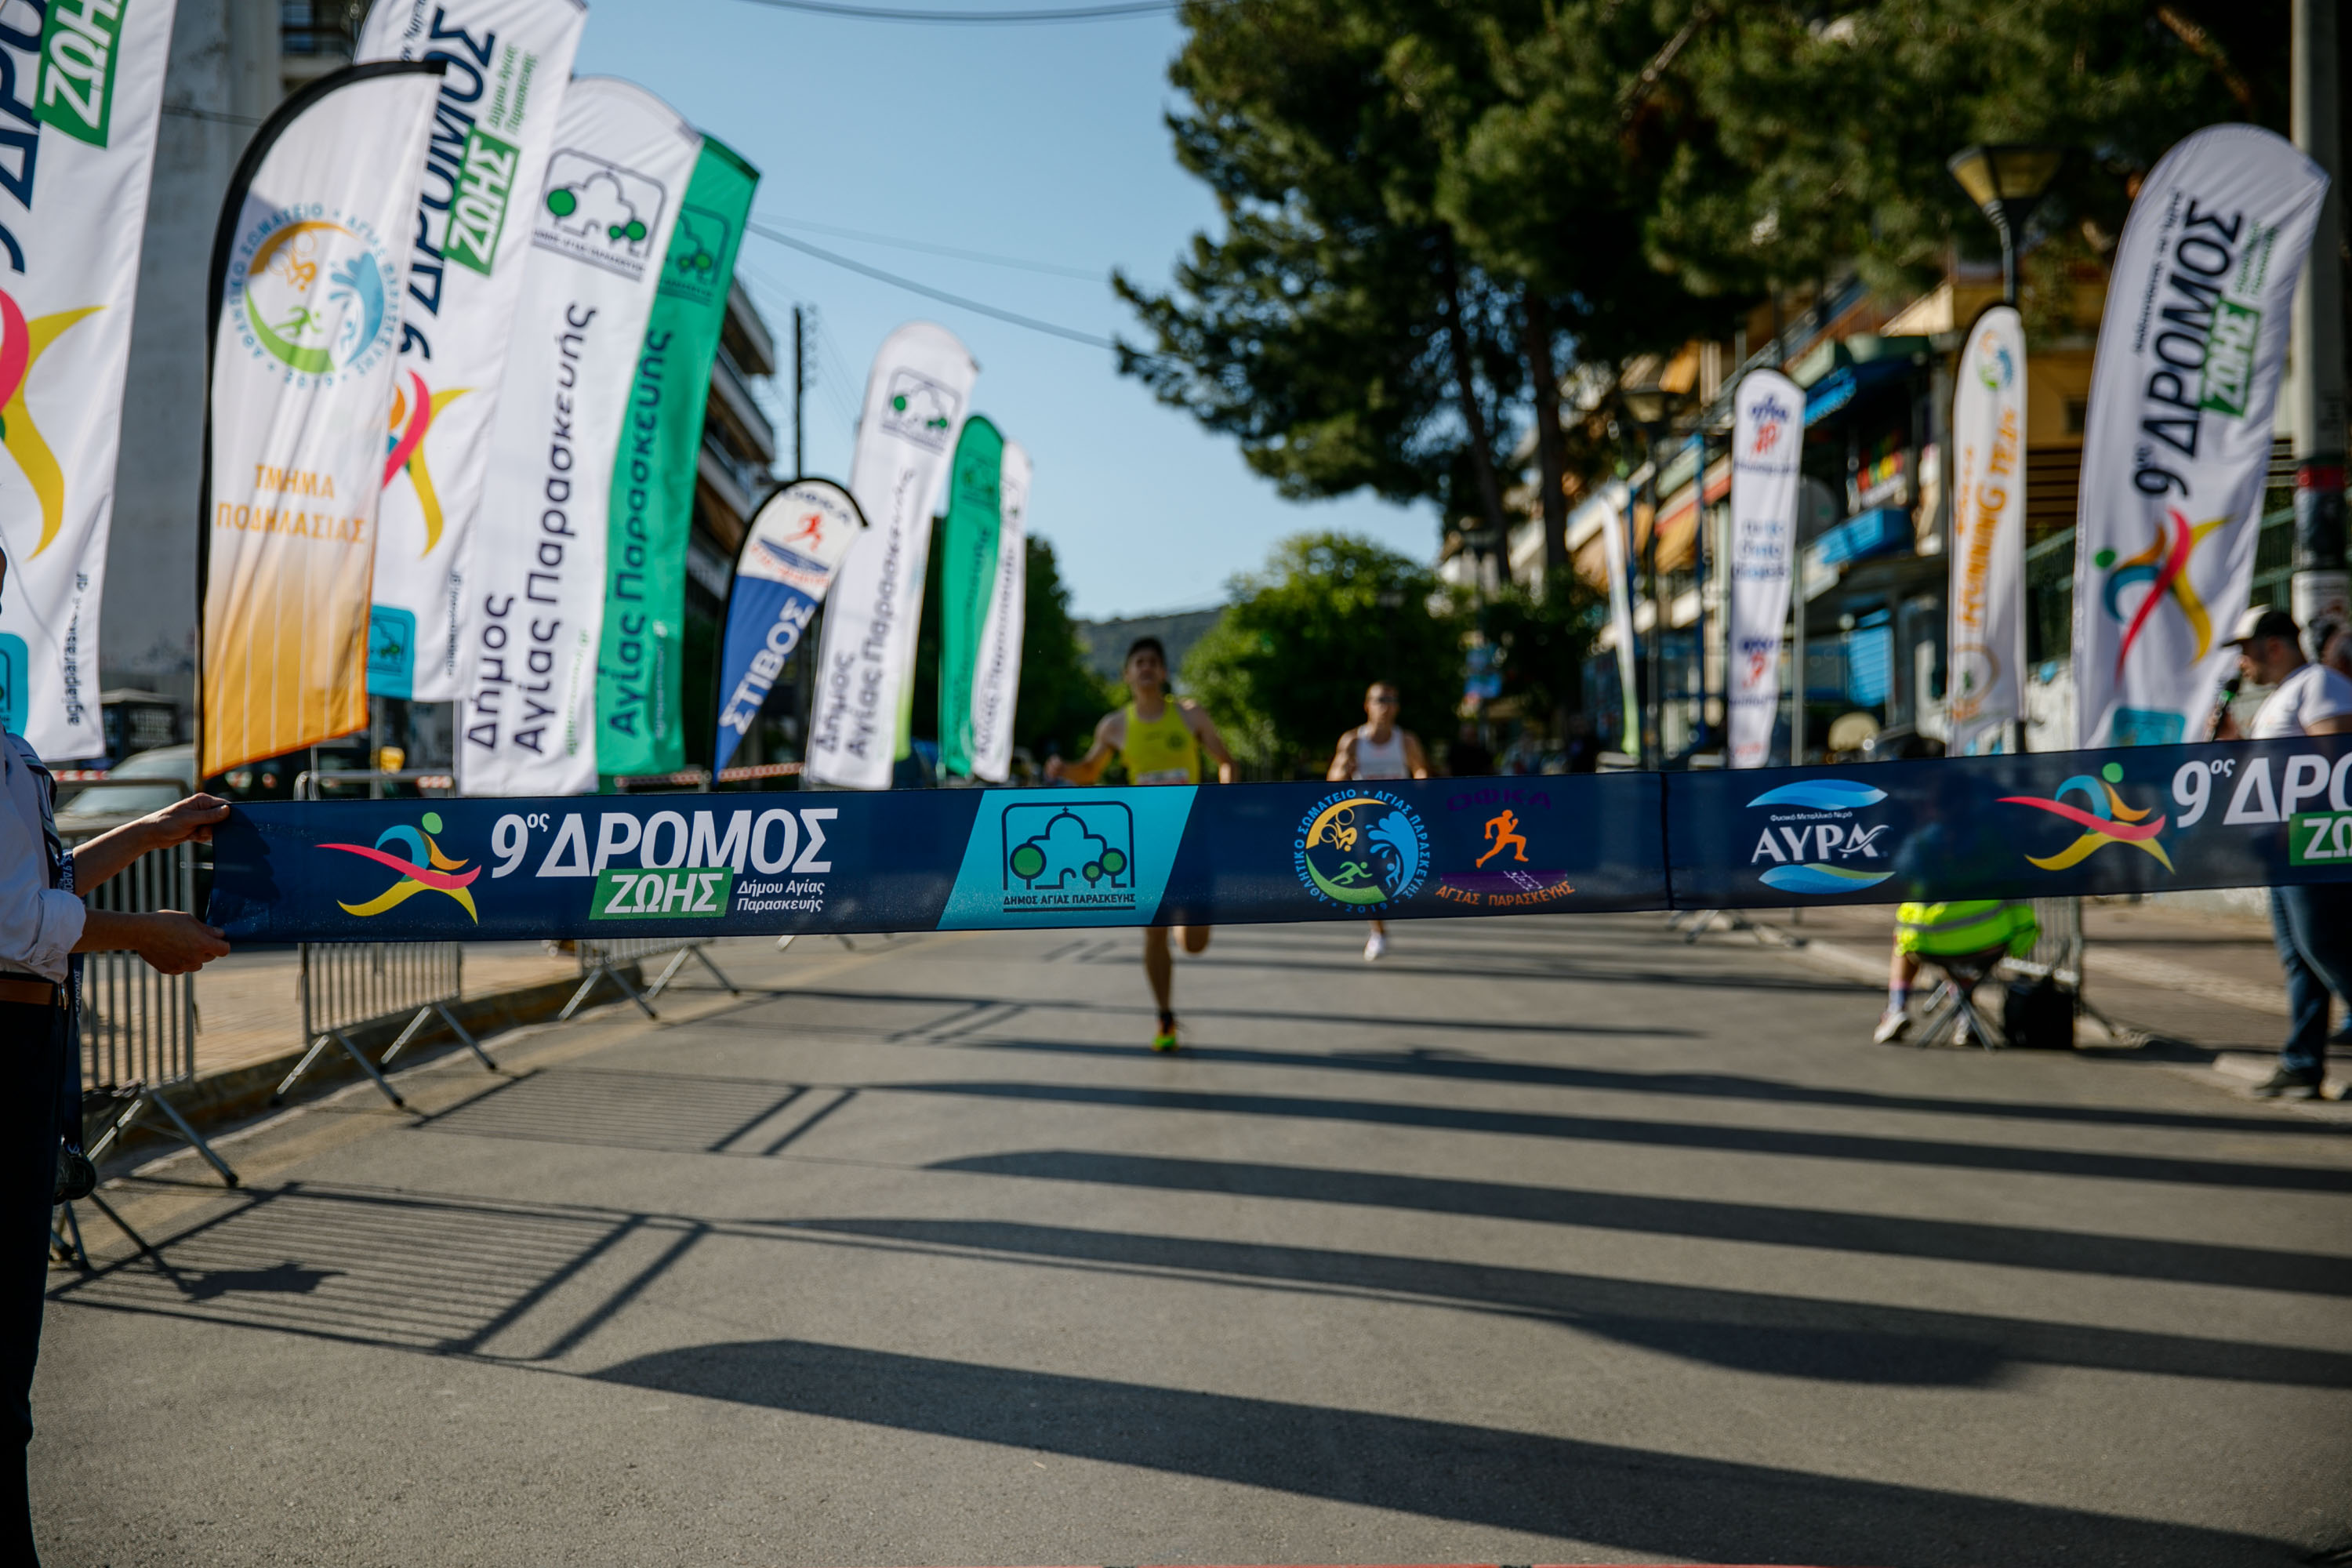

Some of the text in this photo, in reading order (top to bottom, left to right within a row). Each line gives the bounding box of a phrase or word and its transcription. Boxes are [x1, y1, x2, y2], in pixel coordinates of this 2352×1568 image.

[43, 0, 120, 129] ΖΩΗ
[448, 134, 515, 265] ΖΩΗΣ
[2141, 199, 2242, 459] ΔΡΟΜΟΣ
[2204, 303, 2258, 414] ΖΩΗΣ
[255, 463, 336, 500] ΤΜΗΜΑ
[527, 303, 597, 606] Παρασκευής
[216, 502, 365, 543] ΠΟΔΗΛΑΣΙΑΣ
[468, 592, 515, 751] Δήμος
[514, 619, 561, 755] Αγίας
[610, 614, 647, 737] Αγίας
[719, 596, 815, 736] ΣΤΙΒΟΣ
[535, 808, 838, 877] ΔΡΟΜΟΣ
[1446, 788, 1552, 811] ΟΦΚΑ
[737, 879, 826, 897] Δήμου Αγίας
[1294, 789, 1431, 902] ΑΘΛΗΤΙΚΟ ΣΩΜΑΤΕΙΟ ΑΓΙΑΣ ΠΑΡΑΣΚΕΥΗΣ
[604, 873, 723, 914] ΖΩΗΣ
[737, 895, 823, 913] Παρασκευής
[1004, 893, 1136, 906] ΔΗΜΟΣ ΑΓΙΑΣ ΠΑΡΑΣΚΕΥΗΣ
[1345, 903, 1388, 914] 2019
[1435, 880, 1575, 906] ΑΓΙΑΣ ΠΑΡΑΣΚΕΥΗΣ
